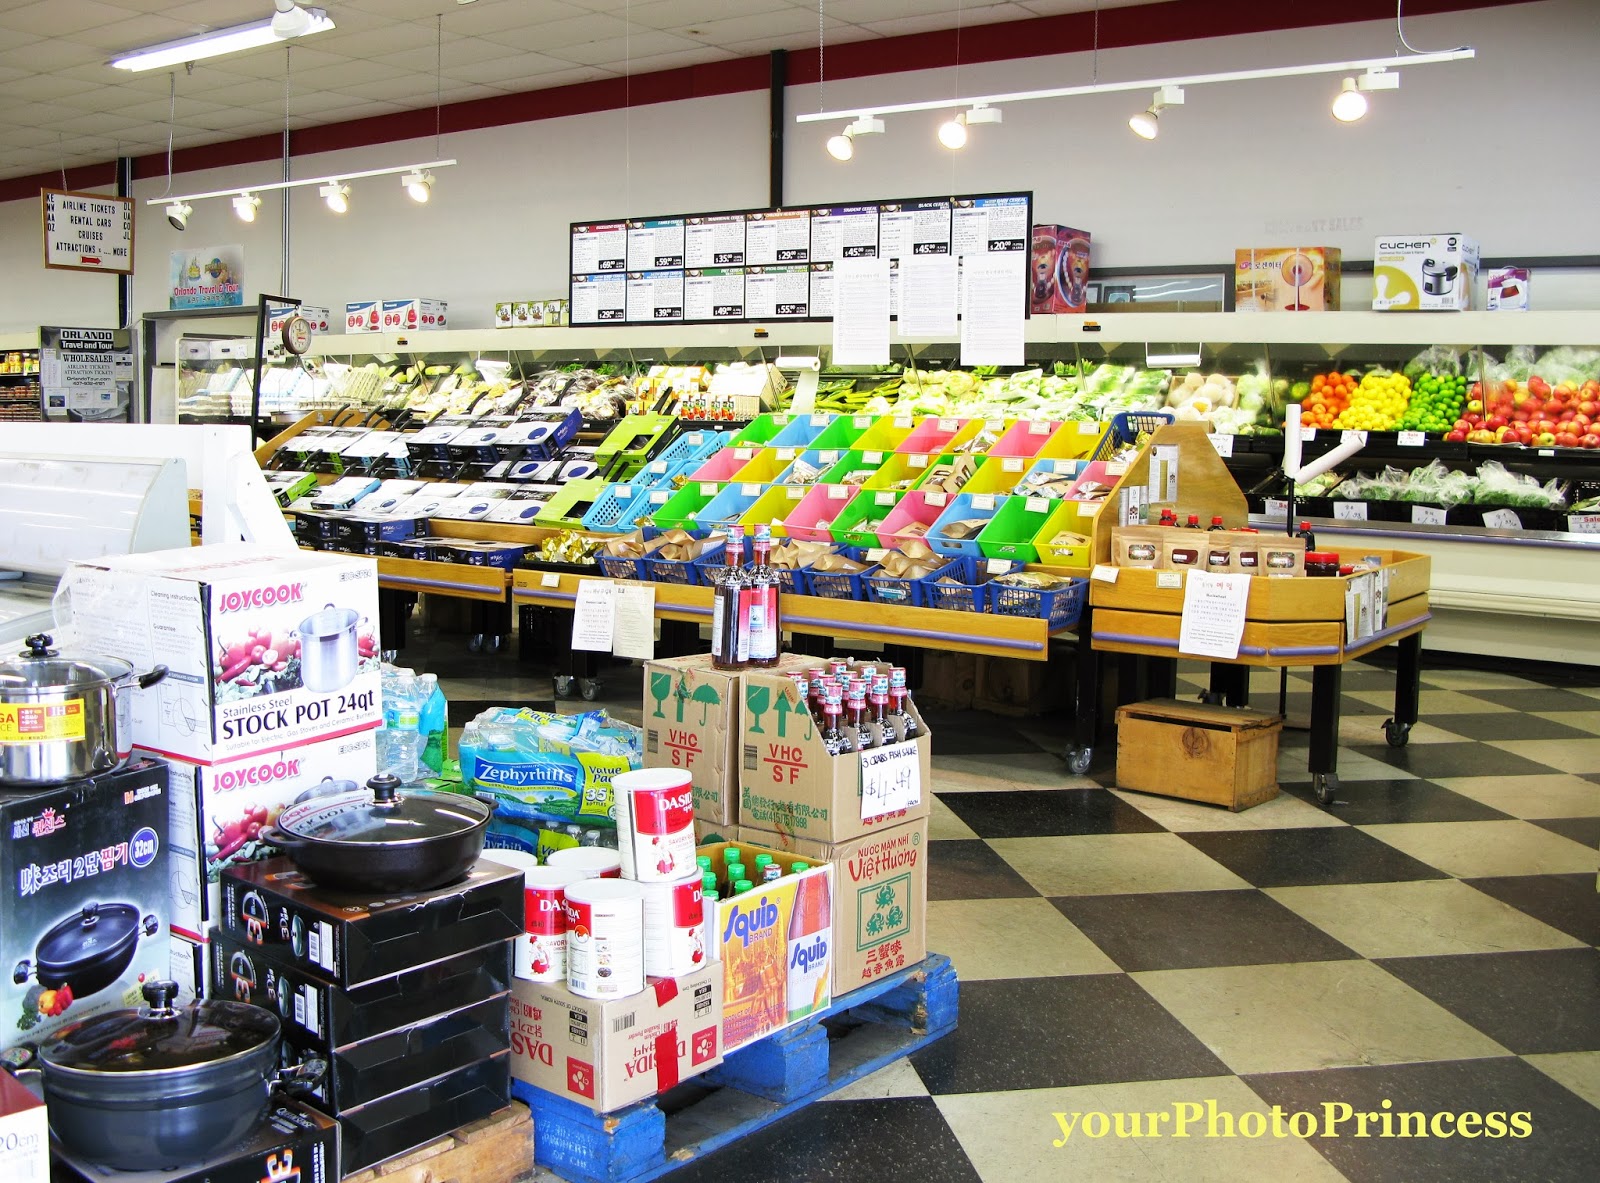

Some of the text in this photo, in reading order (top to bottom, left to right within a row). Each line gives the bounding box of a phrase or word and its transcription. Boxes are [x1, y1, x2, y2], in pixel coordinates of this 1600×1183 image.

[62, 200, 116, 214] AIRLINE TICKETS
[47, 214, 55, 222] AA
[70, 215, 112, 228] RENTAL CARS
[123, 211, 131, 220] UA
[47, 223, 55, 232] OZ
[78, 230, 103, 241] CRUISES
[56, 242, 128, 257] ATTRACTIONS MORE
[915, 244, 935, 254] $45.00
[990, 241, 1012, 251] $20.00
[1379, 241, 1431, 250] CUCHEN
[174, 286, 197, 296] Orlando
[198, 285, 217, 295] Travel
[225, 283, 239, 293] Tour
[62, 330, 112, 340] ORLANDO
[62, 340, 113, 350] Travel and Tour
[62, 354, 113, 363] WHOLESALER
[151, 590, 170, 600] Cleaning
[219, 582, 302, 613] JOYCOOK
[153, 623, 176, 633] Guarantee
[222, 694, 293, 719] Stainless Steel
[222, 689, 374, 740] STOCK POT 24qt
[319, 720, 331, 729] and
[669, 728, 698, 748] VHC
[769, 743, 803, 762] VHC
[862, 757, 869, 768] 3
[870, 753, 888, 766] CRABS
[889, 749, 902, 760] FISH
[213, 758, 300, 793] JOYCOOK
[478, 763, 574, 785] Zephyrhills
[588, 765, 622, 775] Value
[865, 765, 911, 806] $4.49
[585, 787, 607, 801] 35
[134, 838, 154, 859] 32cm
[749, 927, 773, 944] BRAND
[807, 960, 825, 971] BRAND
